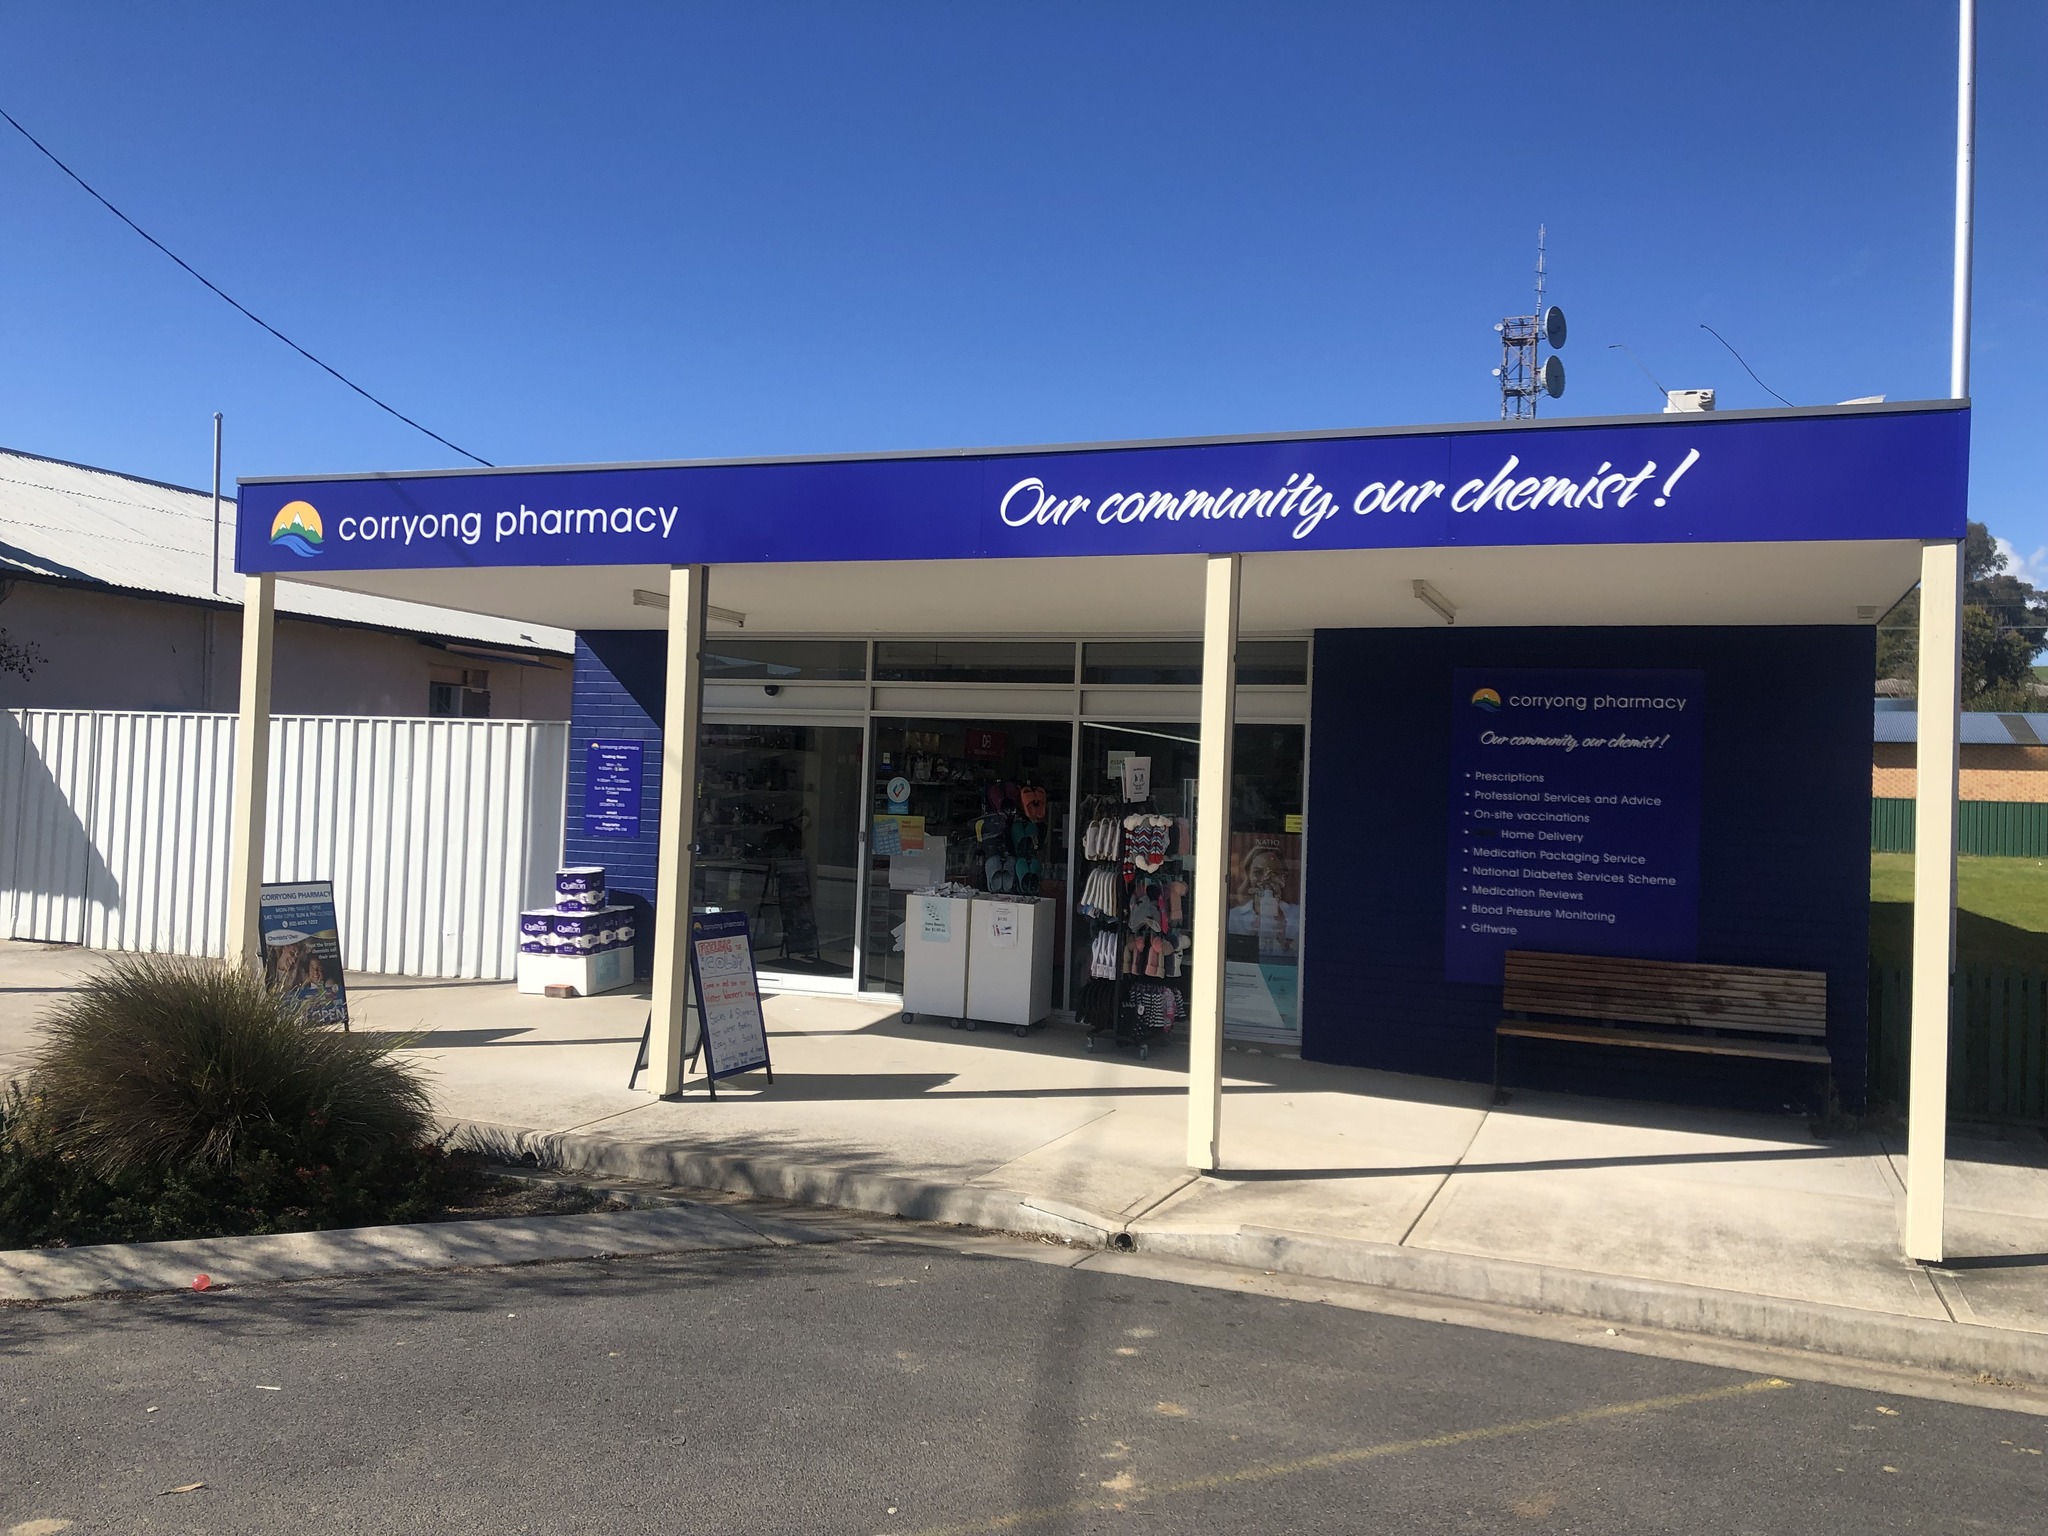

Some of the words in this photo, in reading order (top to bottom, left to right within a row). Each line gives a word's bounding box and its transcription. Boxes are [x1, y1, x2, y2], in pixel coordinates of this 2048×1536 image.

[999, 476, 1091, 527] Our
[1095, 472, 1340, 540] community,
[1352, 479, 1446, 515] our
[338, 511, 482, 546] corryong
[495, 503, 678, 543] pharmacy
[1509, 694, 1588, 711] corryong
[1593, 694, 1687, 712] pharmacy
[1480, 730, 1509, 745] Our
[1510, 734, 1579, 752] community,
[1582, 736, 1608, 748] our
[1475, 771, 1545, 783] Prescriptions
[1474, 790, 1540, 802] Professional
[1543, 792, 1591, 804] Services
[1594, 793, 1617, 805] and
[1621, 795, 1662, 806] Advice
[1474, 809, 1513, 821] On-site
[1517, 811, 1590, 823] vaccinations
[1255, 838, 1280, 846] NATIO
[1501, 829, 1535, 841] Home
[1538, 831, 1584, 843] Delivery
[1473, 847, 1537, 860] Medication
[1540, 850, 1600, 864] Packaging
[1603, 853, 1646, 865] Service
[1472, 866, 1520, 878] National
[1523, 868, 1574, 880] Diabetes
[1577, 871, 1624, 883] Services
[1628, 874, 1676, 886] Scheme
[560, 881, 586, 890] Quilton
[1472, 885, 1536, 898] Medication
[1539, 888, 1584, 900] Reviews
[261, 892, 297, 901] CORRYONG
[298, 890, 331, 899] PHARMACY
[1471, 904, 1503, 916] Blood
[1506, 906, 1552, 918] Pressure
[1555, 909, 1616, 924] Monitoring
[524, 923, 548, 932] Quilton
[556, 925, 581, 934] Quilton
[1471, 923, 1518, 936] Giftware
